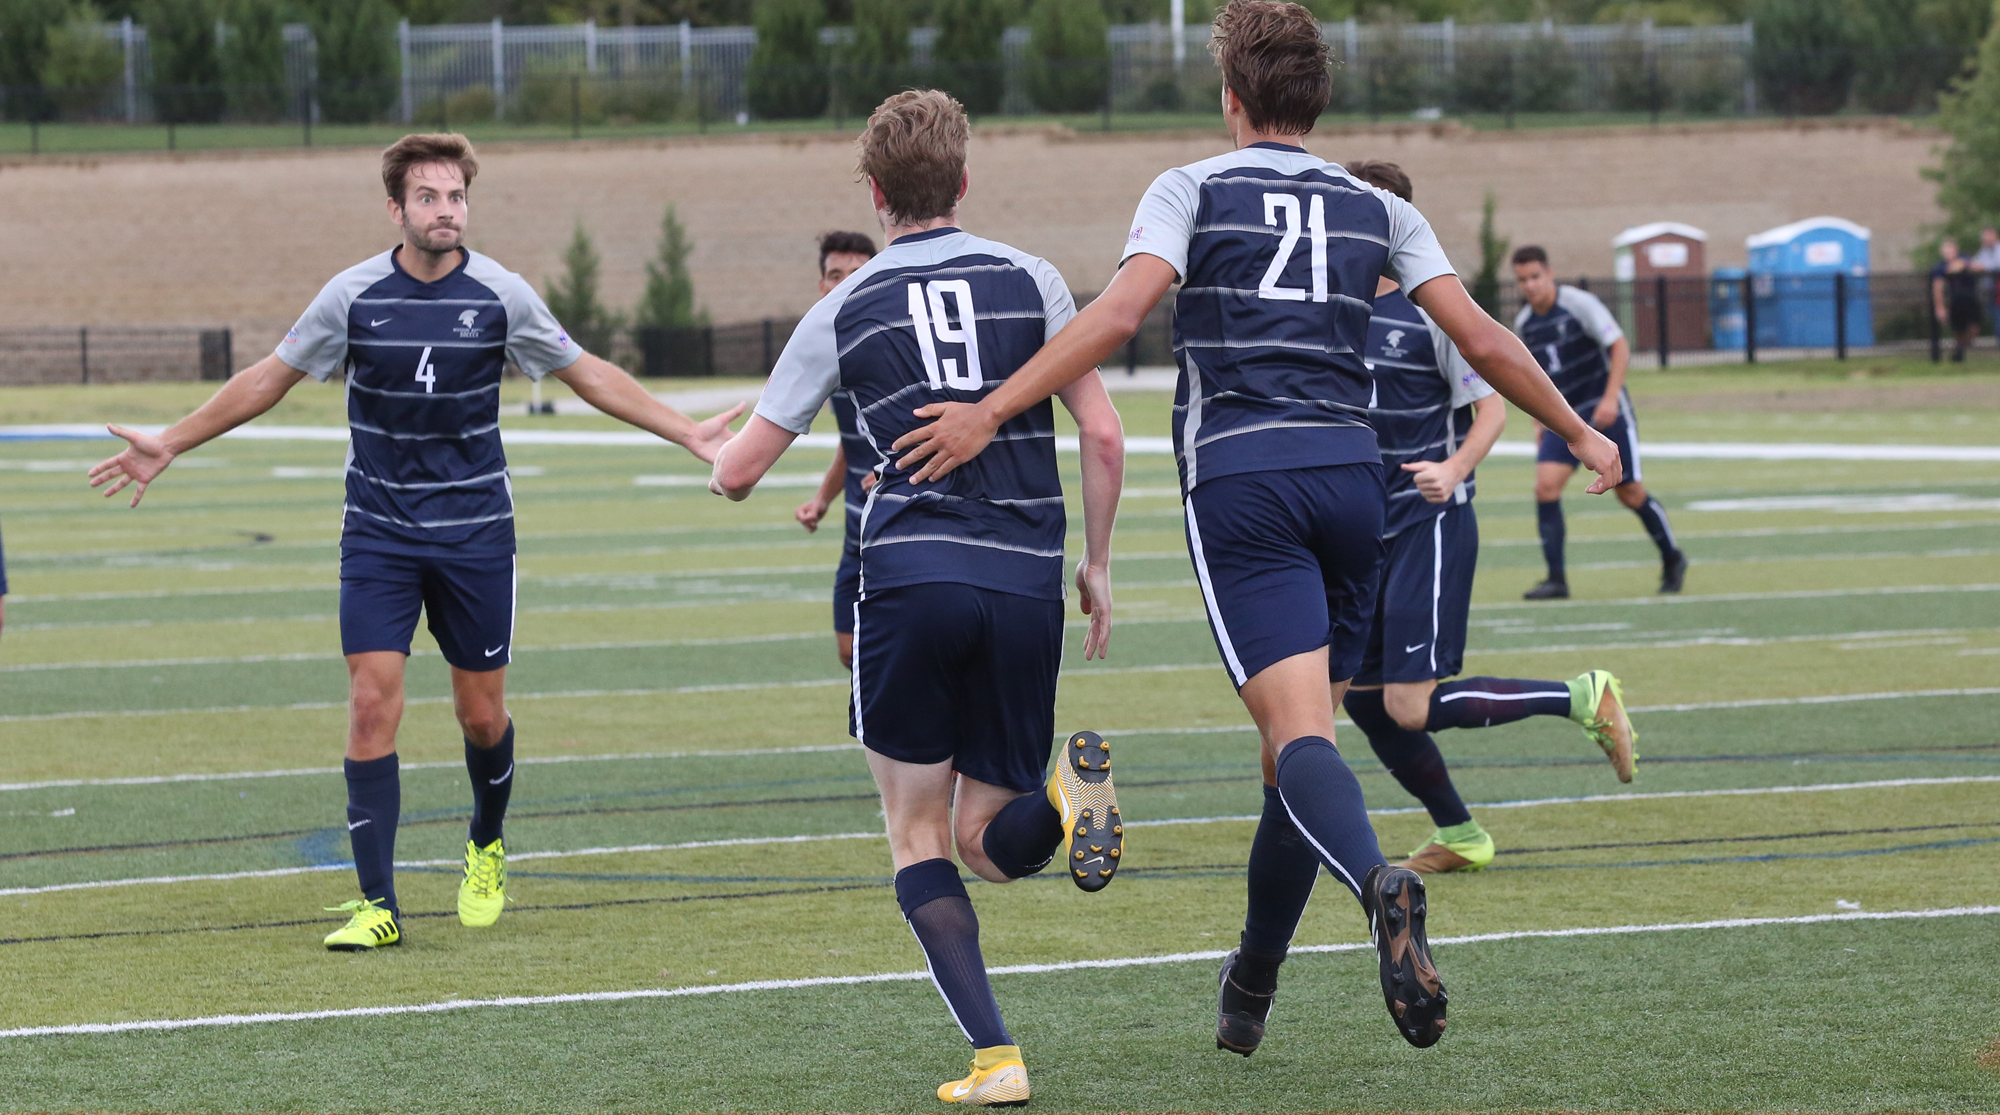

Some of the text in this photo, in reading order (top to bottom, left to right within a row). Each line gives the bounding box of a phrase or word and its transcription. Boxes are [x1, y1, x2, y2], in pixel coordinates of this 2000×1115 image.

[1258, 192, 1328, 302] 21
[415, 346, 436, 393] 4
[908, 279, 983, 391] 19
